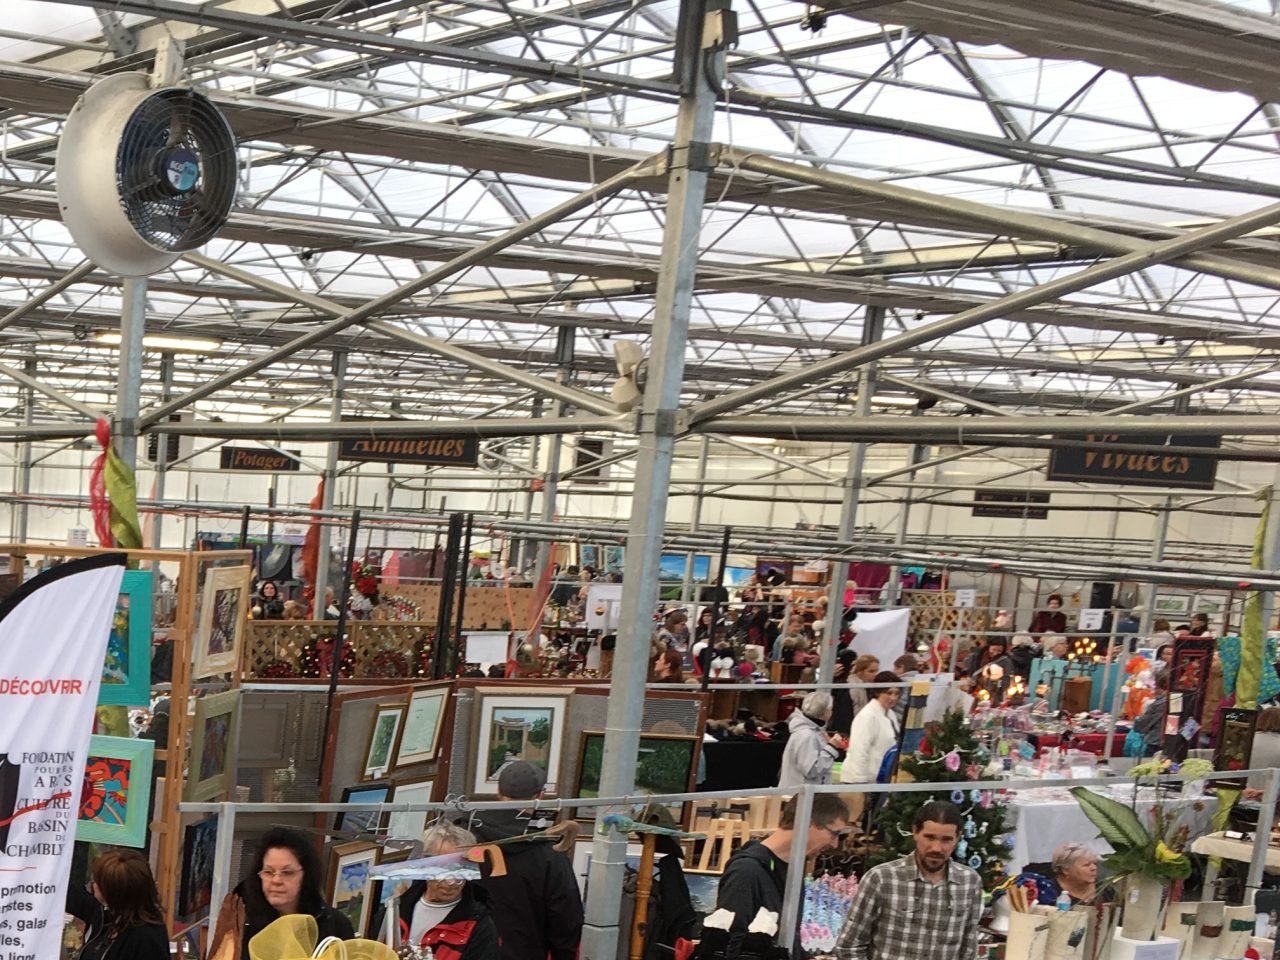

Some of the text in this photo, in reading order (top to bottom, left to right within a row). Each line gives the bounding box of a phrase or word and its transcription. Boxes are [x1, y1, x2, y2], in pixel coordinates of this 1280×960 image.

[234, 451, 288, 468] Potager
[0, 677, 82, 695] DÉCOUVRR
[34, 775, 72, 788] ARS
[1, 883, 56, 899] prmotion
